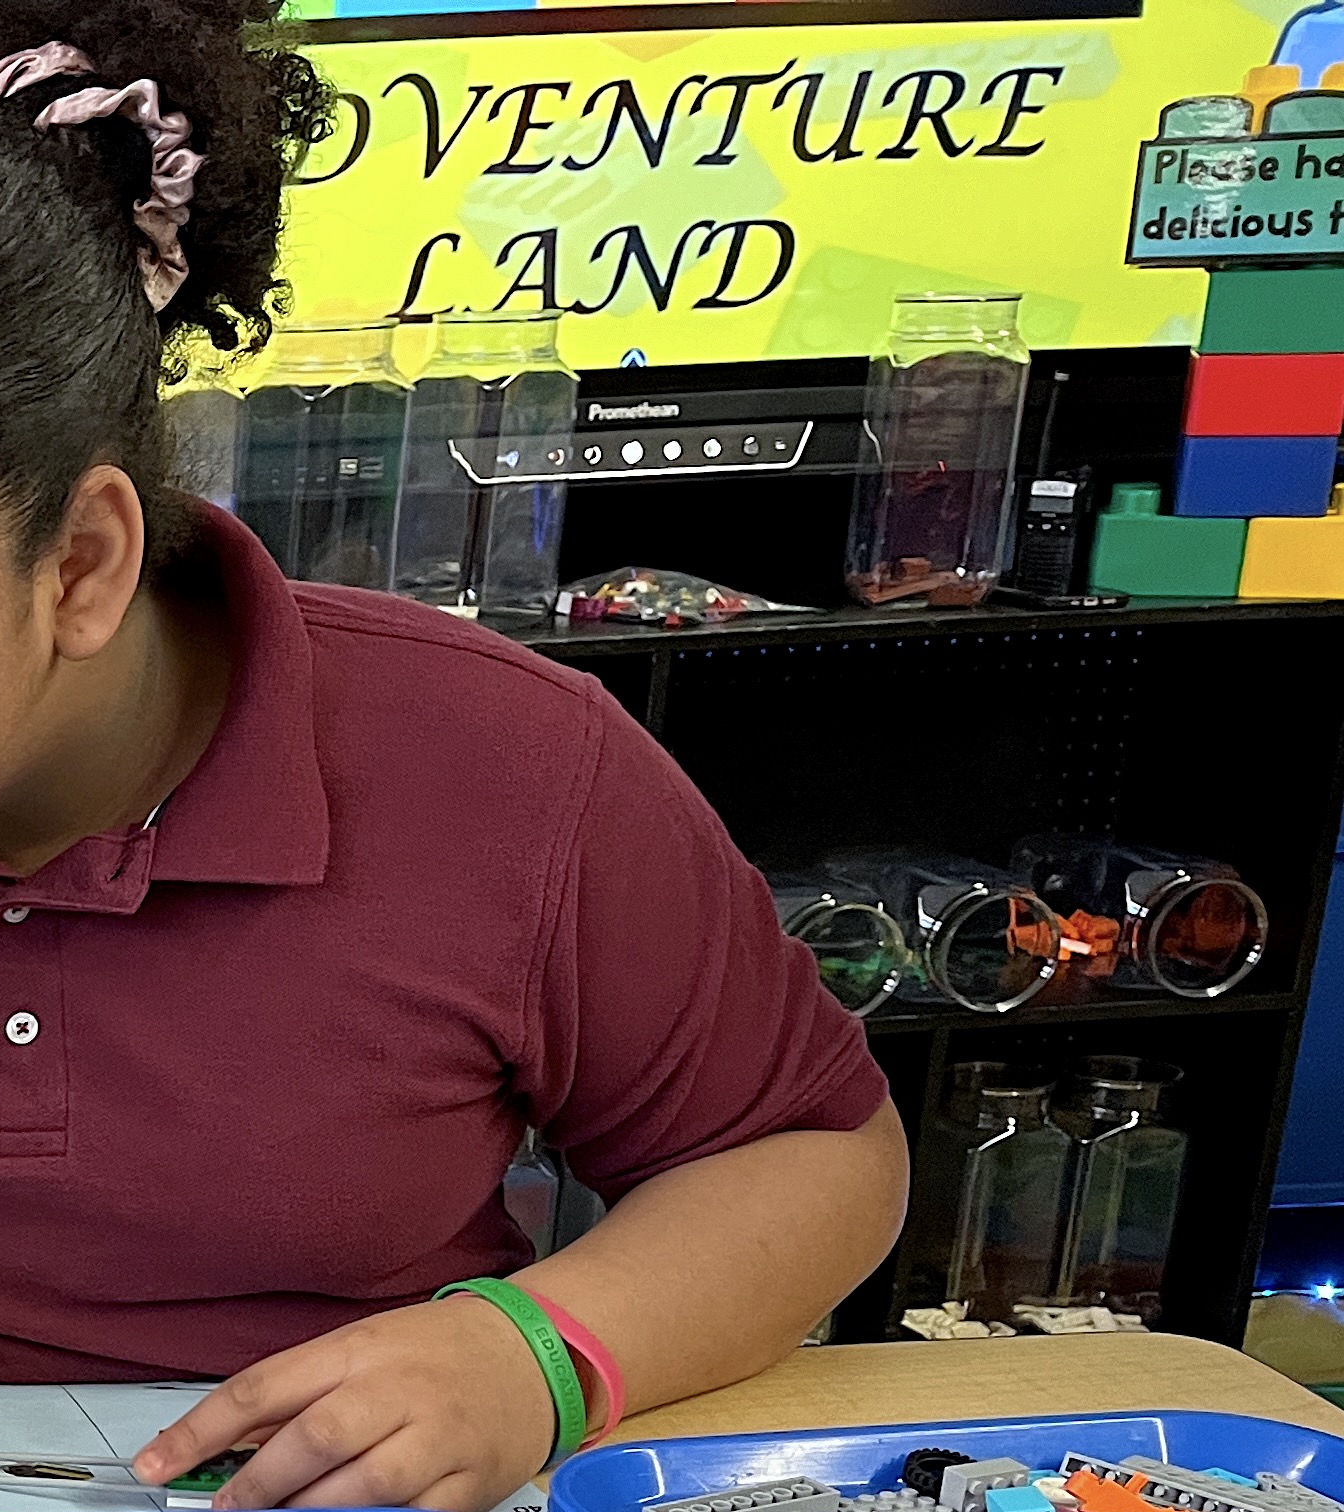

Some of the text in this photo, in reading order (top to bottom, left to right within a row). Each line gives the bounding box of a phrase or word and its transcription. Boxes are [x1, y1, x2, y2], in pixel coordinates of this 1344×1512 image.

[282, 58, 1065, 184] DVENTURE
[1154, 147, 1279, 185] Please
[1143, 204, 1314, 240] delicious
[386, 218, 795, 323] LAND
[588, 401, 680, 421] Promethean
